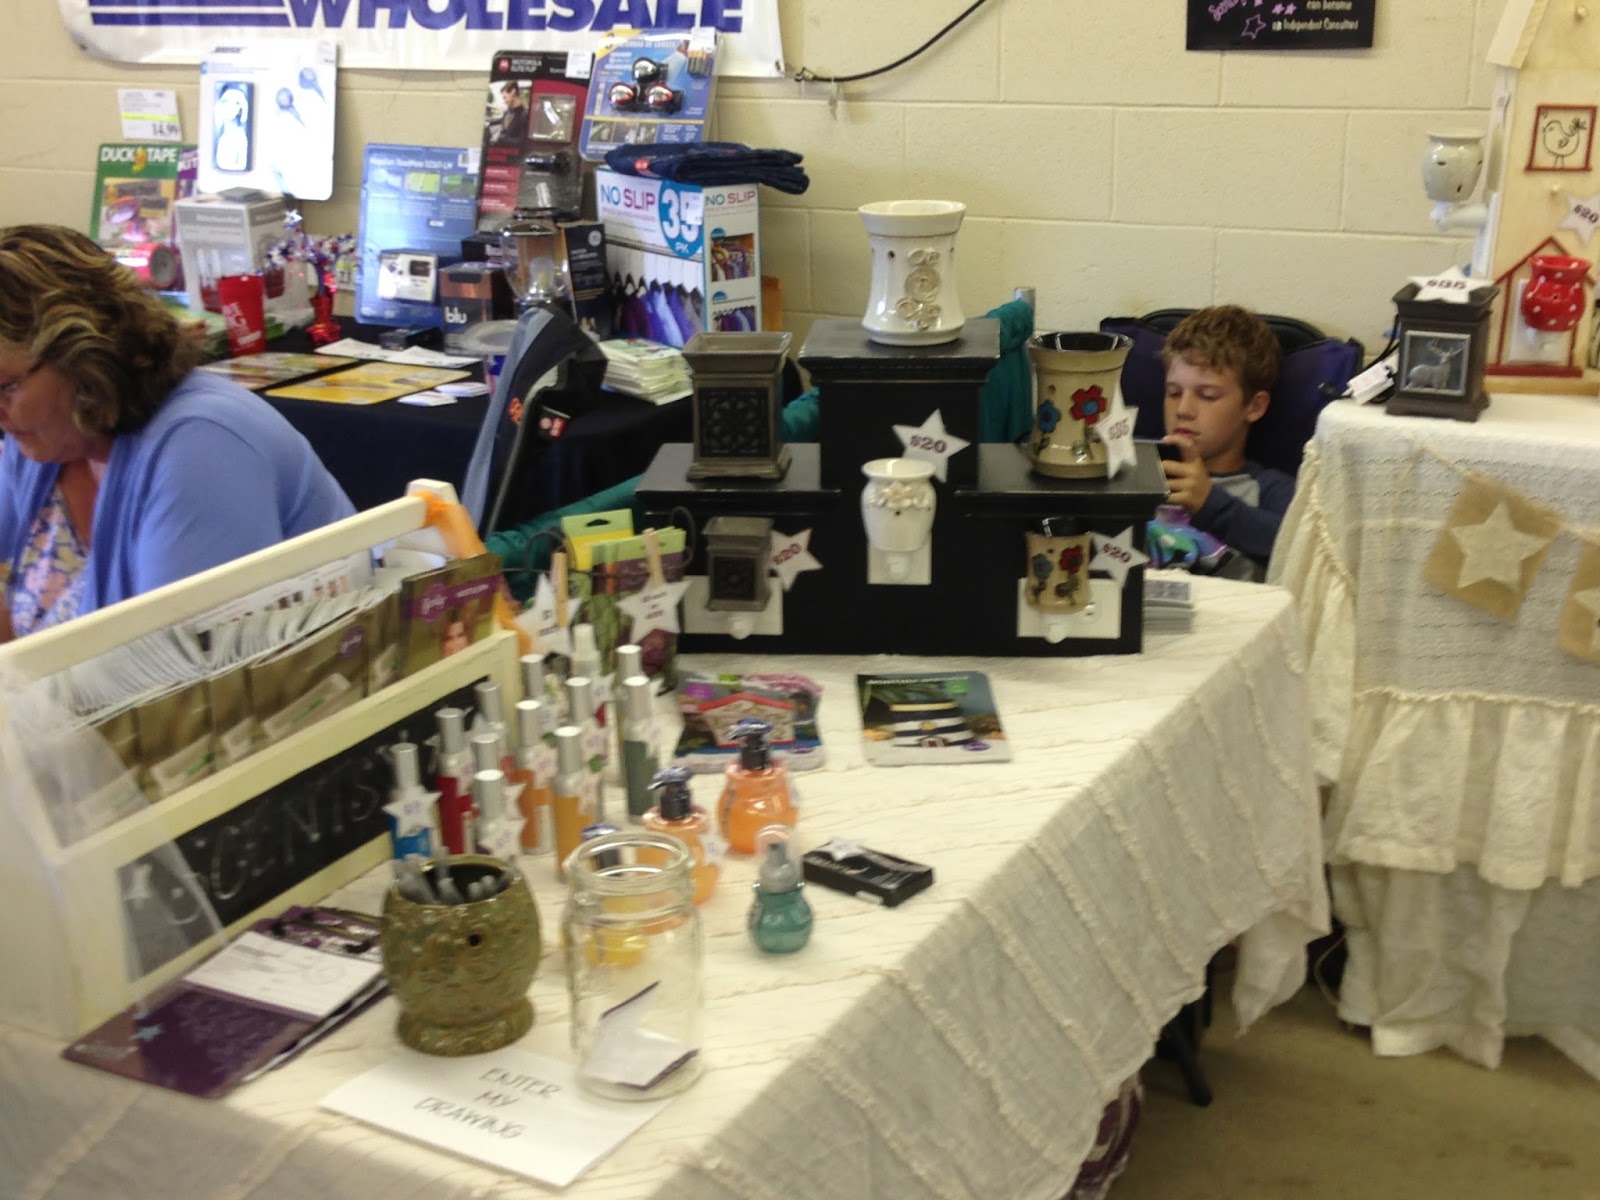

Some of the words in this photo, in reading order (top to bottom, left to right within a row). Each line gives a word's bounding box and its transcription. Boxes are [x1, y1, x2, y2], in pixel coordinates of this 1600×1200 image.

[286, 0, 742, 32] WHOLESALE
[1283, 18, 1322, 32] Independent
[1323, 17, 1359, 31] Consultant
[101, 146, 134, 162] DUCK
[147, 147, 177, 163] TAPE
[600, 184, 621, 206] NO
[623, 188, 656, 211] SLIP
[705, 193, 726, 206] NO
[727, 190, 756, 204] SLIP
[443, 305, 468, 325] blu
[909, 434, 947, 454] $20
[478, 1066, 562, 1099] ENTER
[474, 1090, 521, 1108] MY
[413, 1095, 528, 1140] DRAWING
